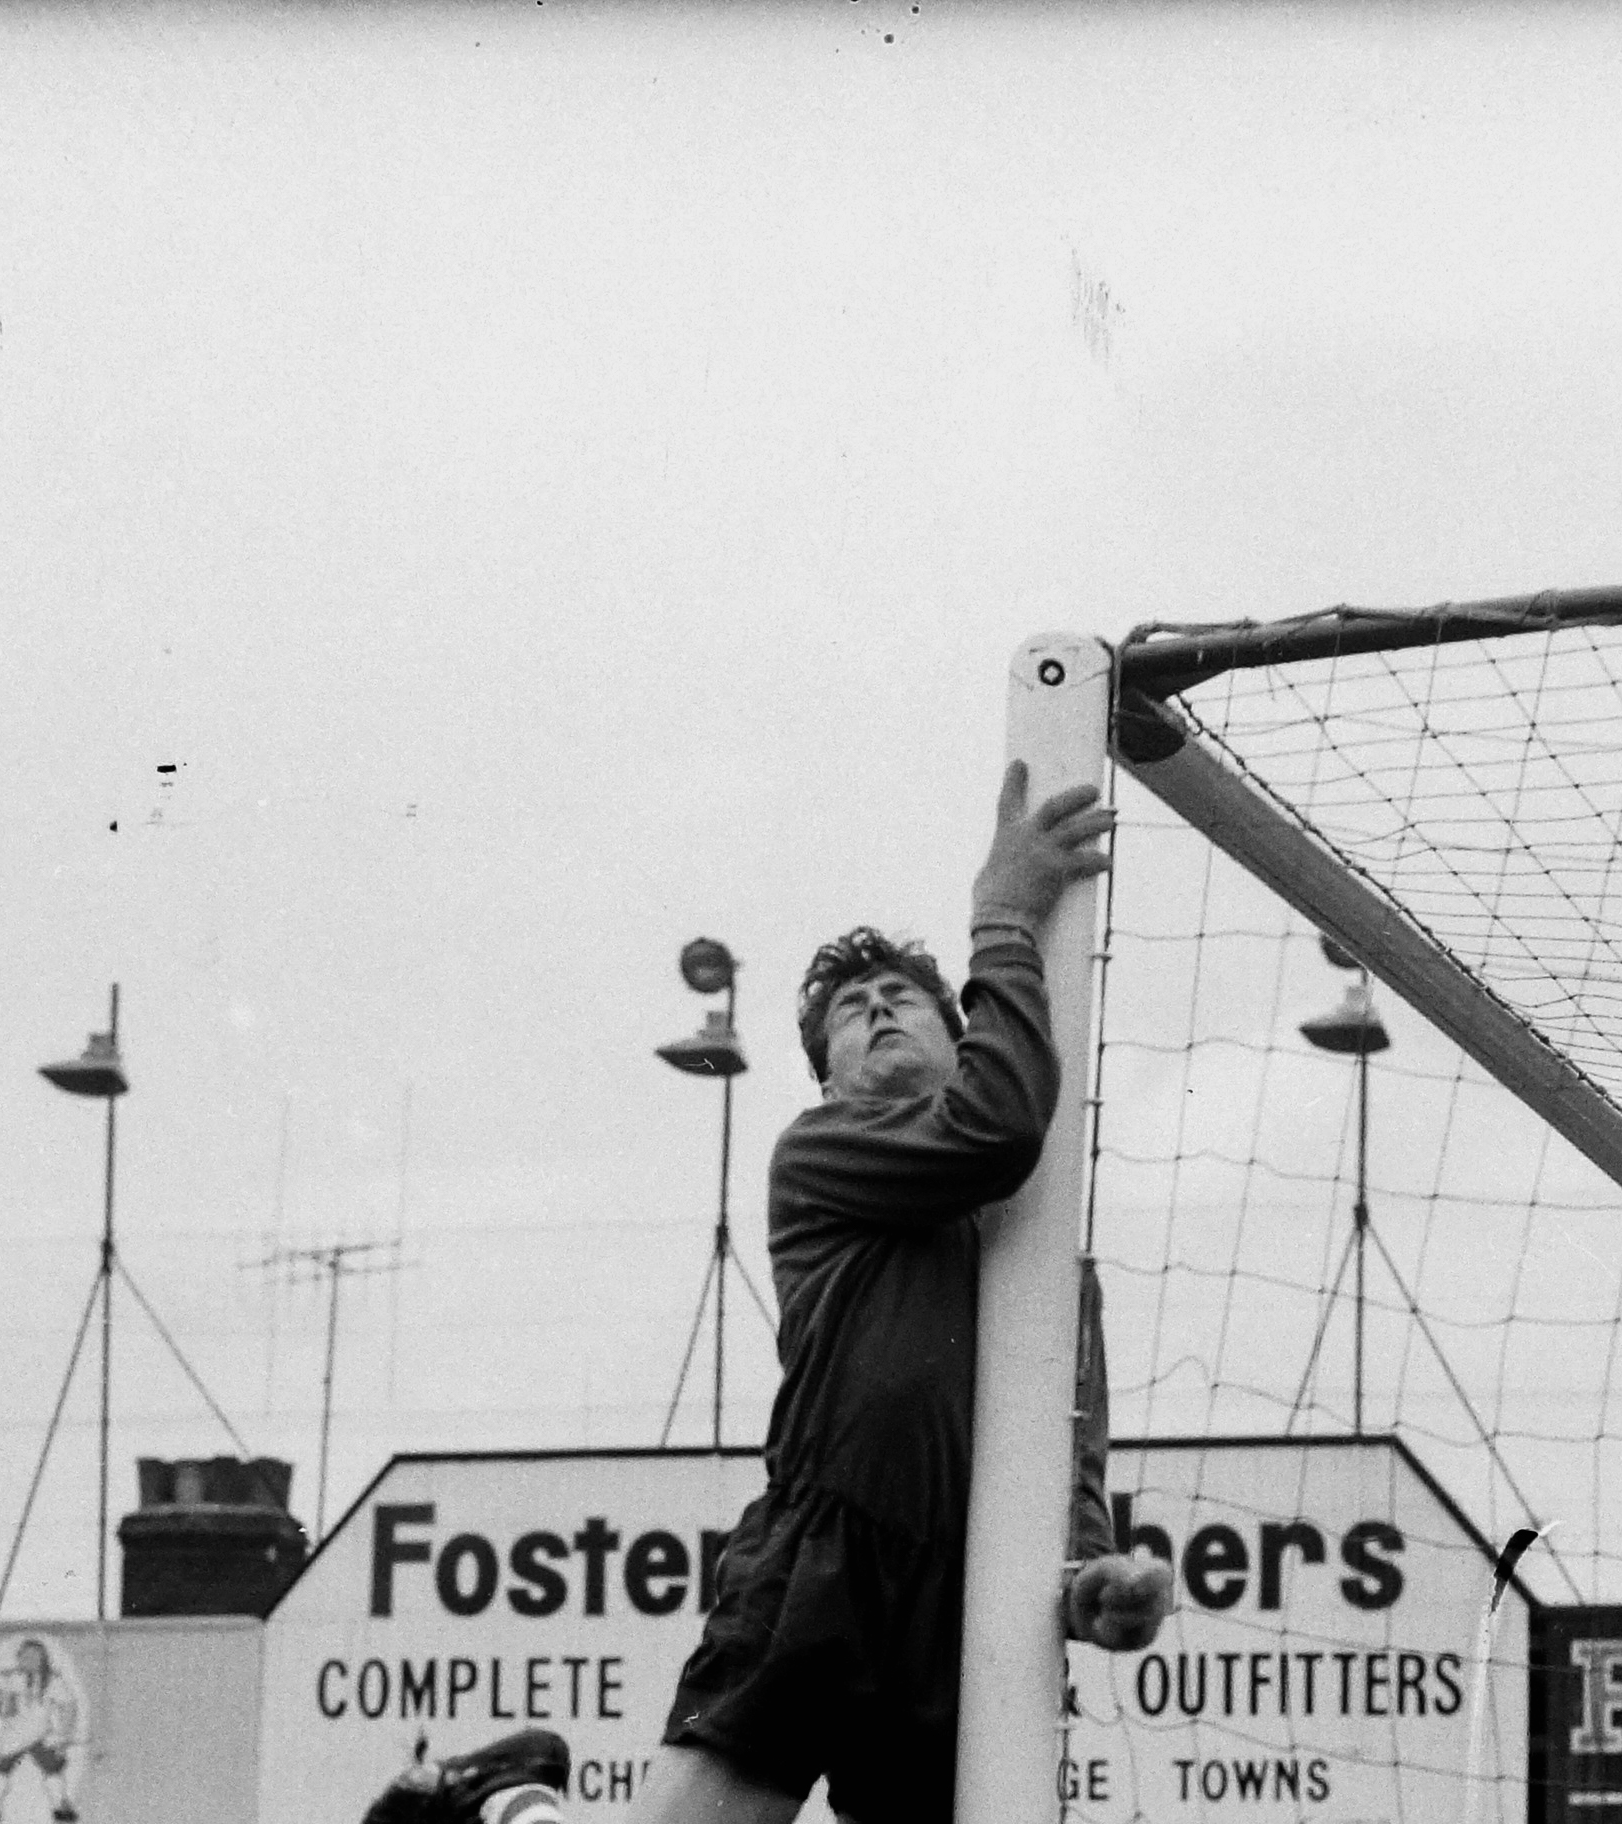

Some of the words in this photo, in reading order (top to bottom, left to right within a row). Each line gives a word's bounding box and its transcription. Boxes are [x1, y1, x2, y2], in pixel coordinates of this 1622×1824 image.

[316, 1655, 624, 1719] COMPLETE
[1135, 1651, 1464, 1718] OUTFITTERS
[1172, 1759, 1332, 1802] TOWNS
